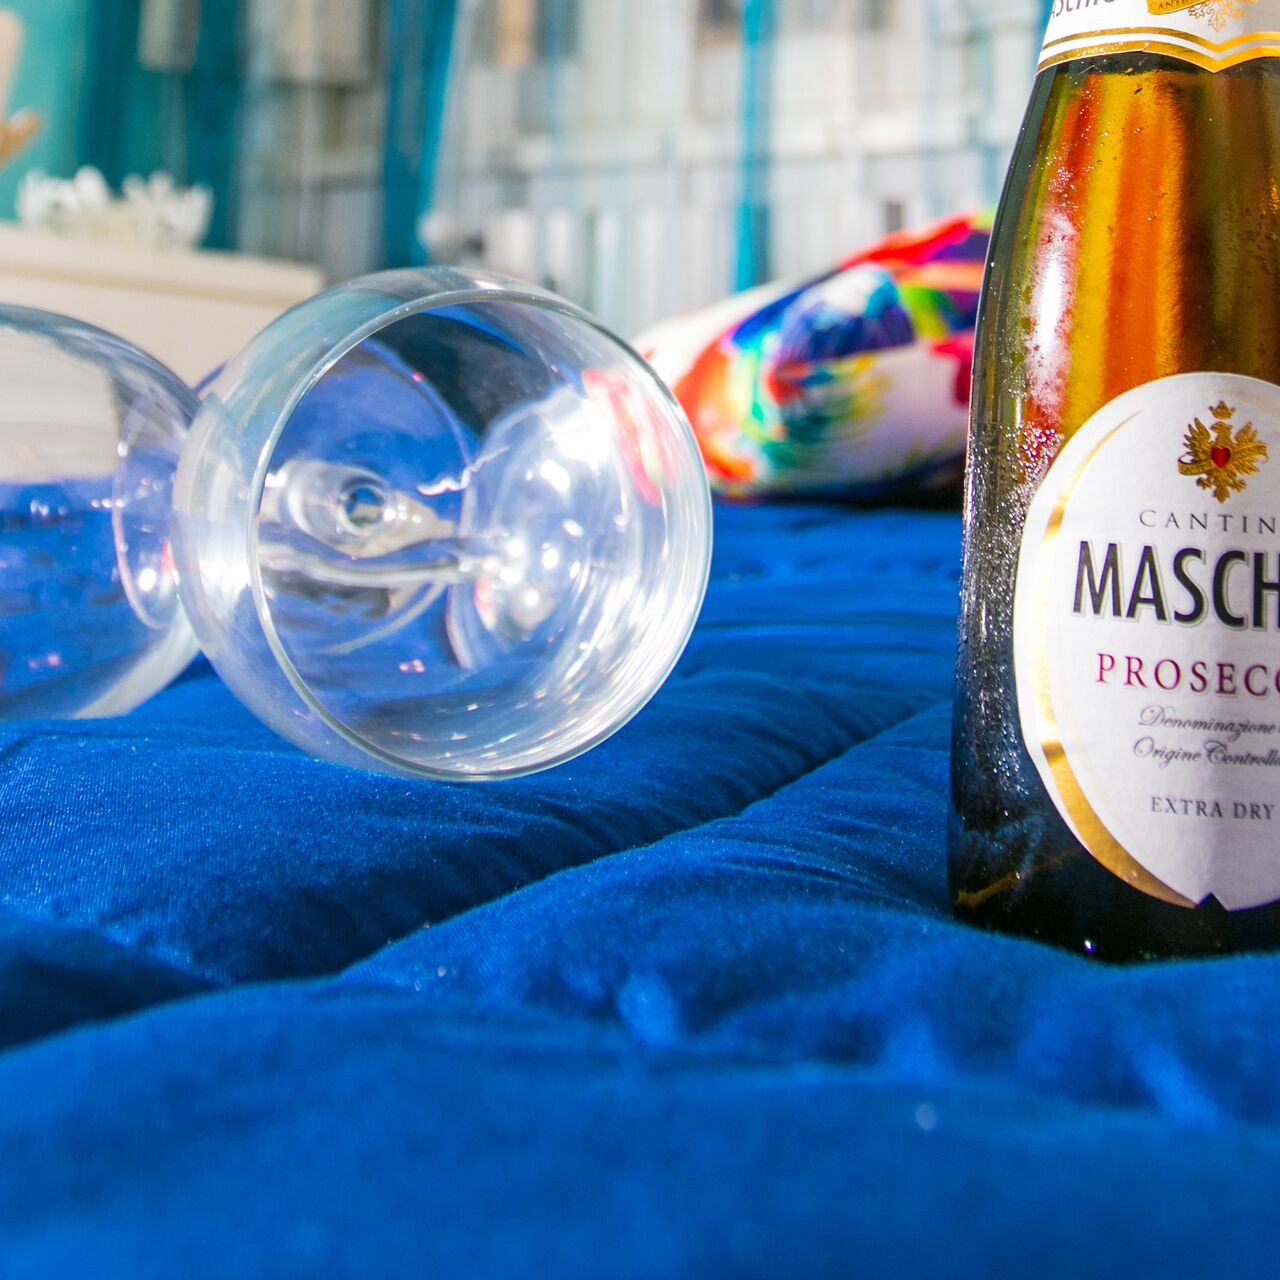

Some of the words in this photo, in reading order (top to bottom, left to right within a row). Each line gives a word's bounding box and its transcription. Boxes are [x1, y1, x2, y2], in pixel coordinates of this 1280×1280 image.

[1138, 705, 1276, 742] Denominazione
[1133, 736, 1202, 768] Origine
[1151, 796, 1224, 818] EXTRA
[1233, 801, 1275, 821] DRY
